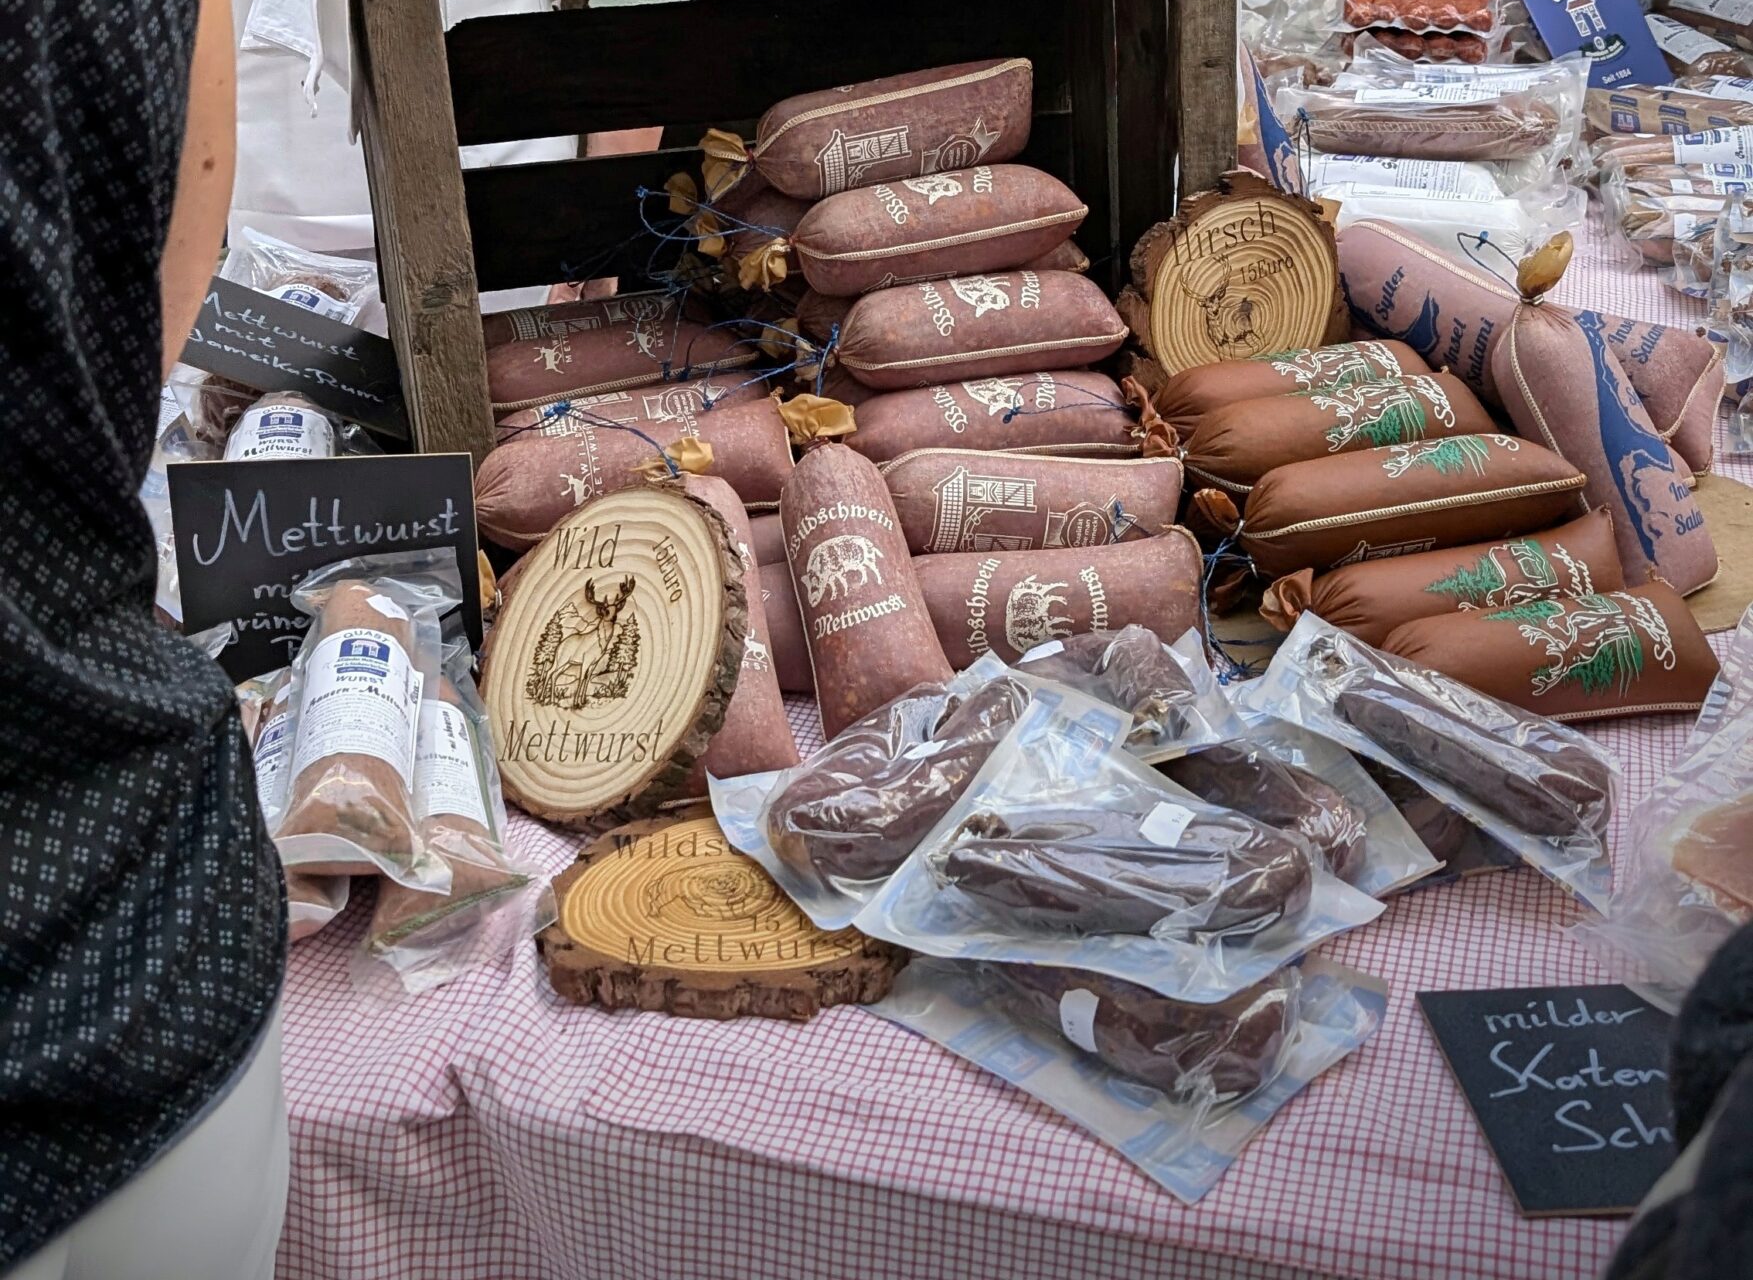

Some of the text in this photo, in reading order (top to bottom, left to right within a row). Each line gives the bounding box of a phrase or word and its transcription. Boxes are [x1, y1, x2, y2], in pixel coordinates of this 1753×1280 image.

[1171, 201, 1277, 267] Hirsch
[1375, 266, 1405, 320] Sylter
[214, 322, 276, 349] mit
[1442, 316, 1467, 366] Insel
[192, 488, 460, 566] Mettwurst
[553, 524, 622, 570] Wild
[789, 500, 894, 561] Wildschwein
[652, 535, 684, 604] 15Euro
[814, 593, 907, 641] Mettwurst
[965, 557, 1002, 654] ildschwein
[343, 630, 390, 643] QUAST
[336, 675, 385, 685] WURST
[499, 718, 666, 762] Mettwurst
[626, 933, 876, 966] Mettwurst
[1484, 998, 1645, 1034] milder
